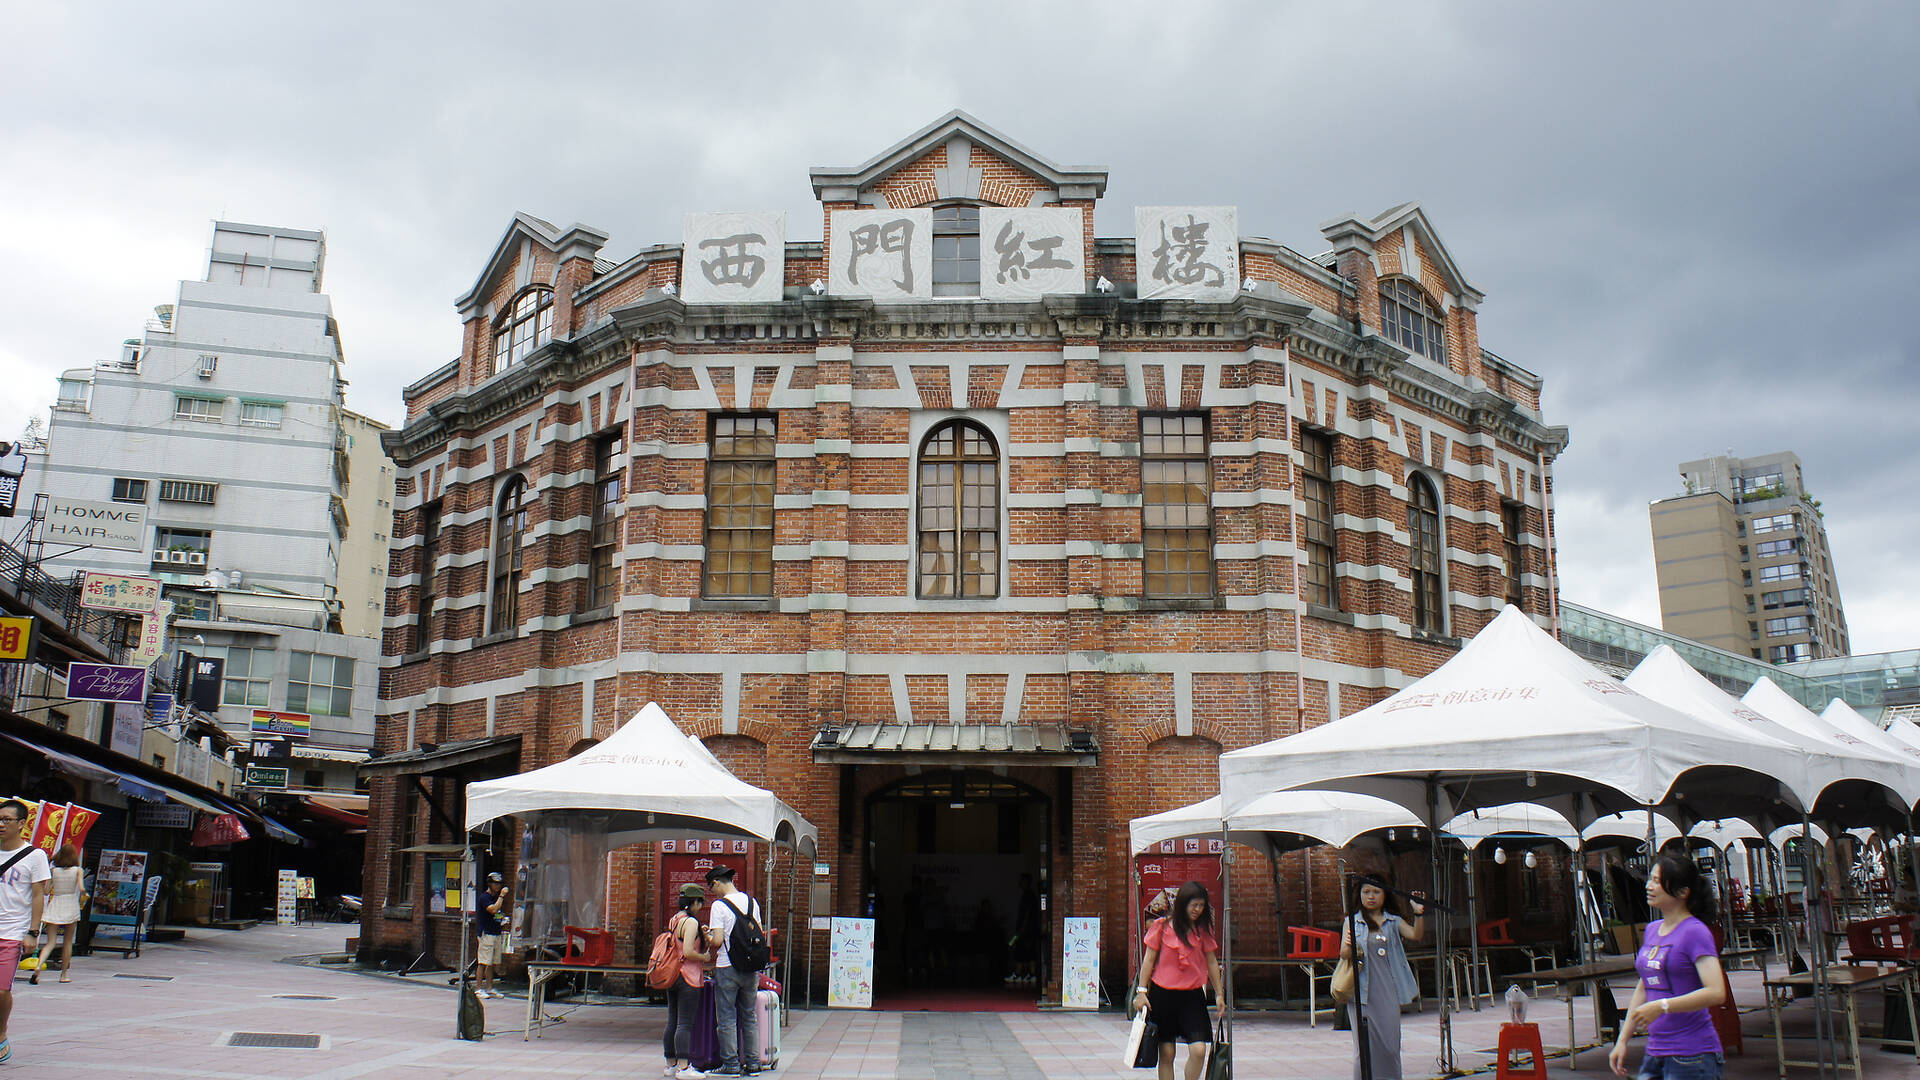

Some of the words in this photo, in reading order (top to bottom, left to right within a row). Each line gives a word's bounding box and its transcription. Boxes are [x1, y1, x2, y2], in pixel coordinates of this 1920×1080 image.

[53, 505, 140, 523] HOMME
[50, 523, 107, 538] HAIR
[94, 667, 143, 686] Nail
